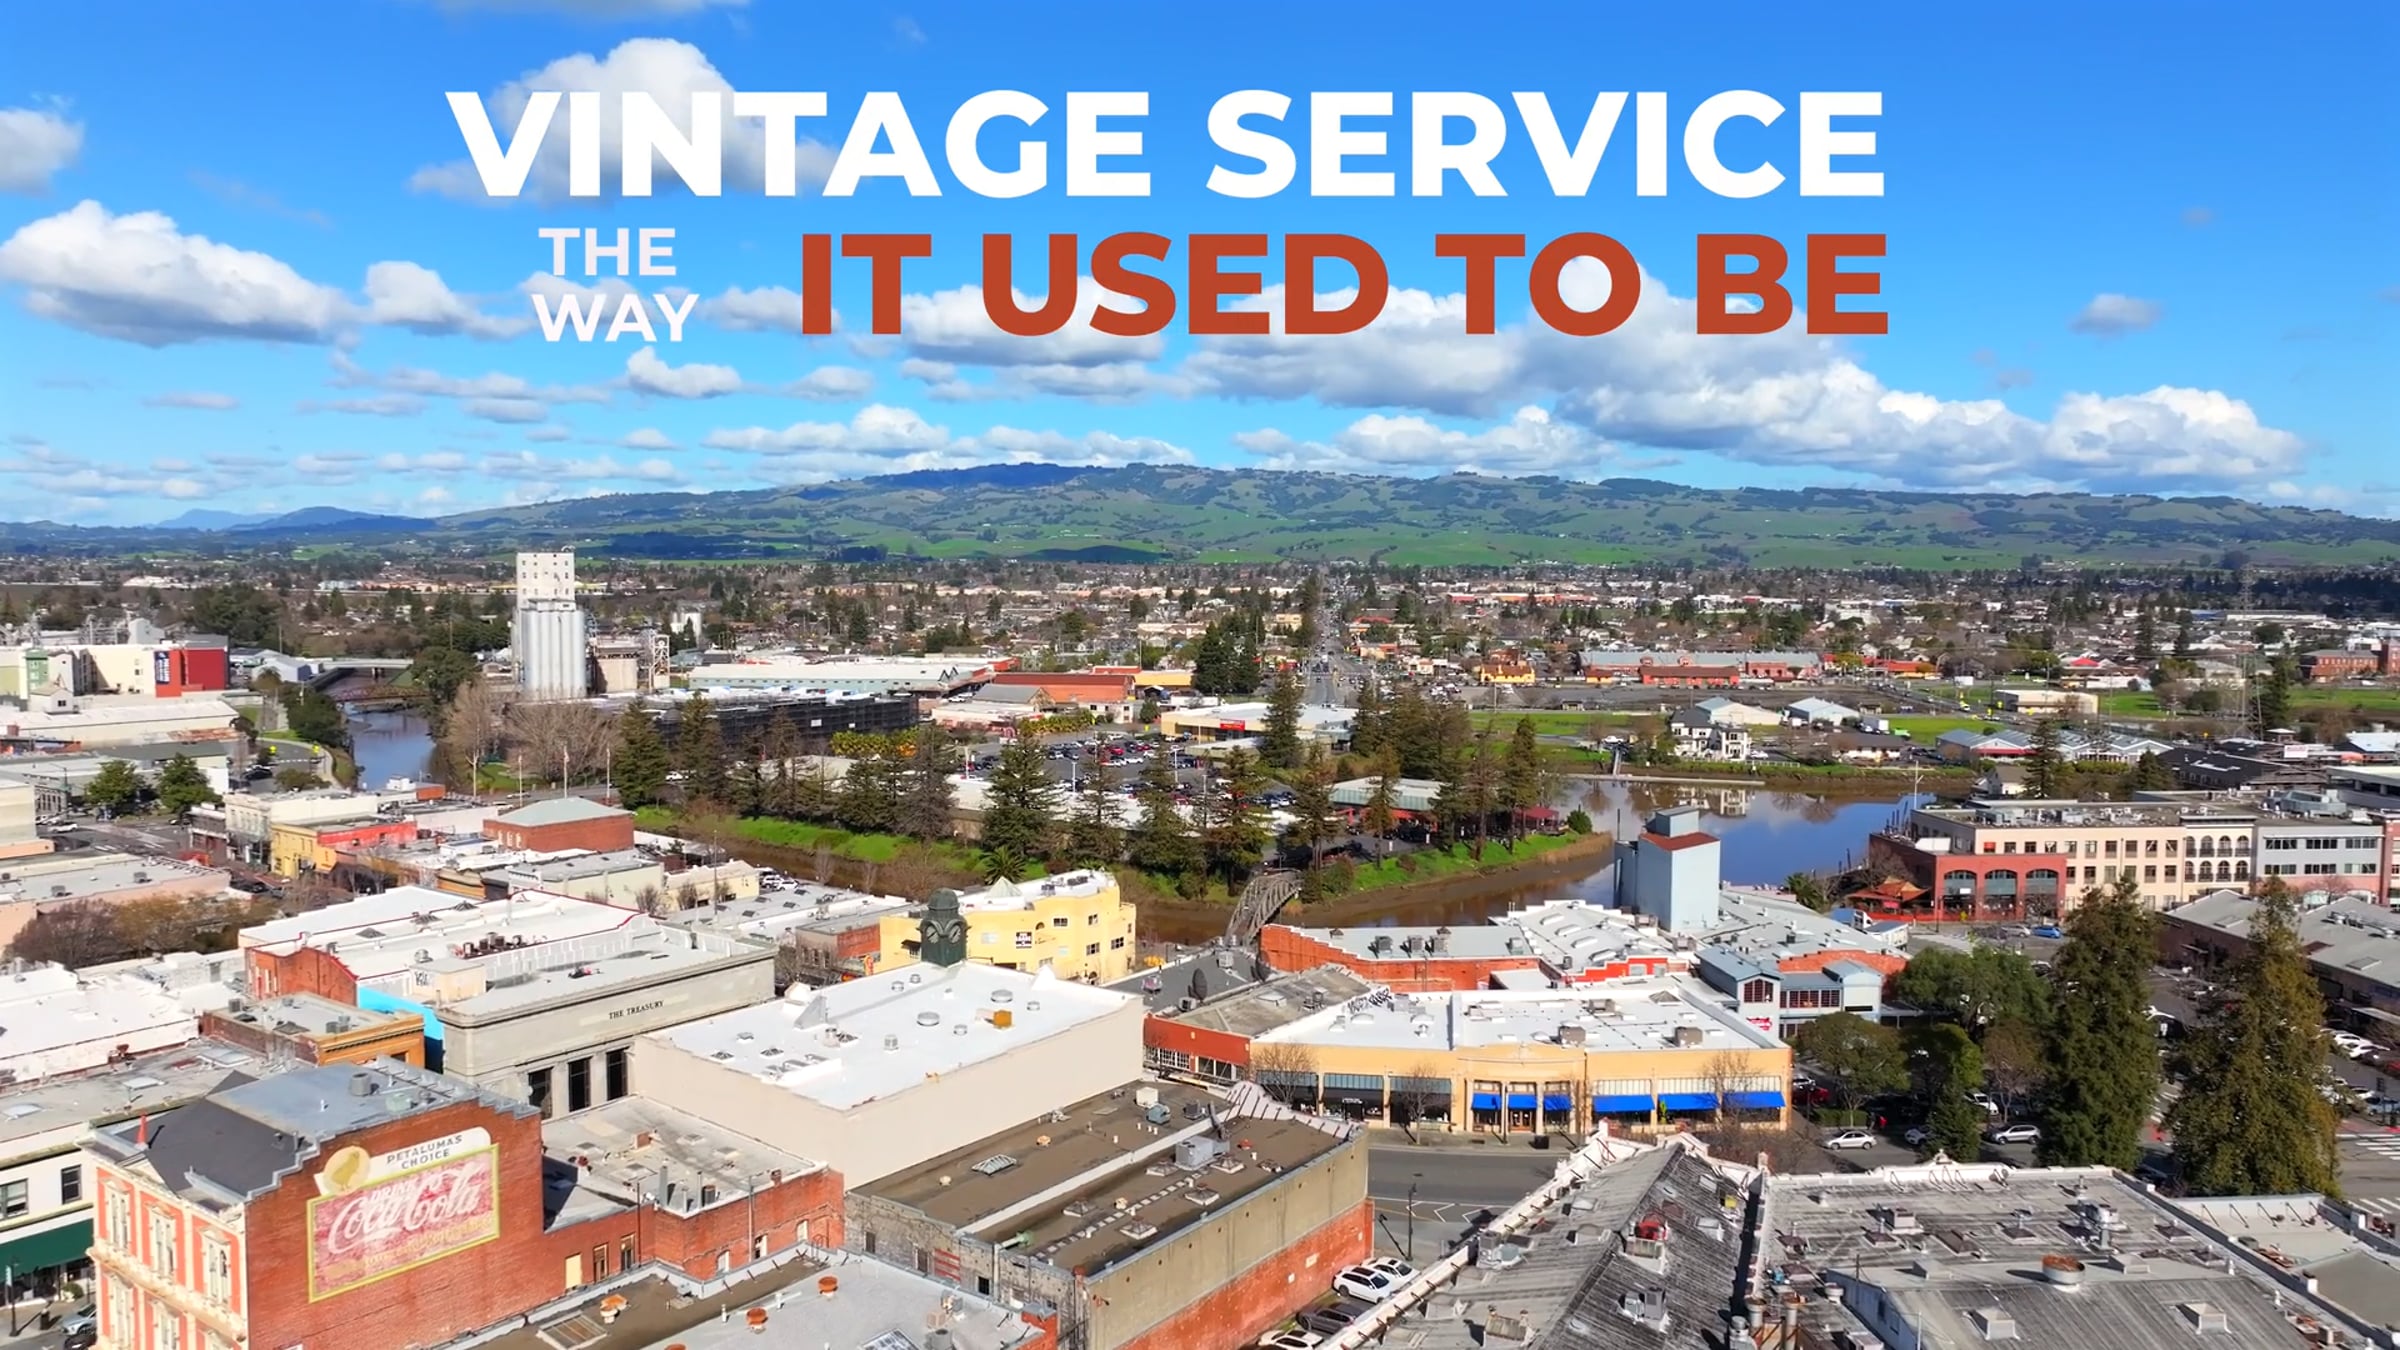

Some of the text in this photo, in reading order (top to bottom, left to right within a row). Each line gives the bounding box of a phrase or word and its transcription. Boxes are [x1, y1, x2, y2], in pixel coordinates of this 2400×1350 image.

[608, 1001, 664, 1019] THE TREASURY
[401, 1148, 450, 1170] CHOICE
